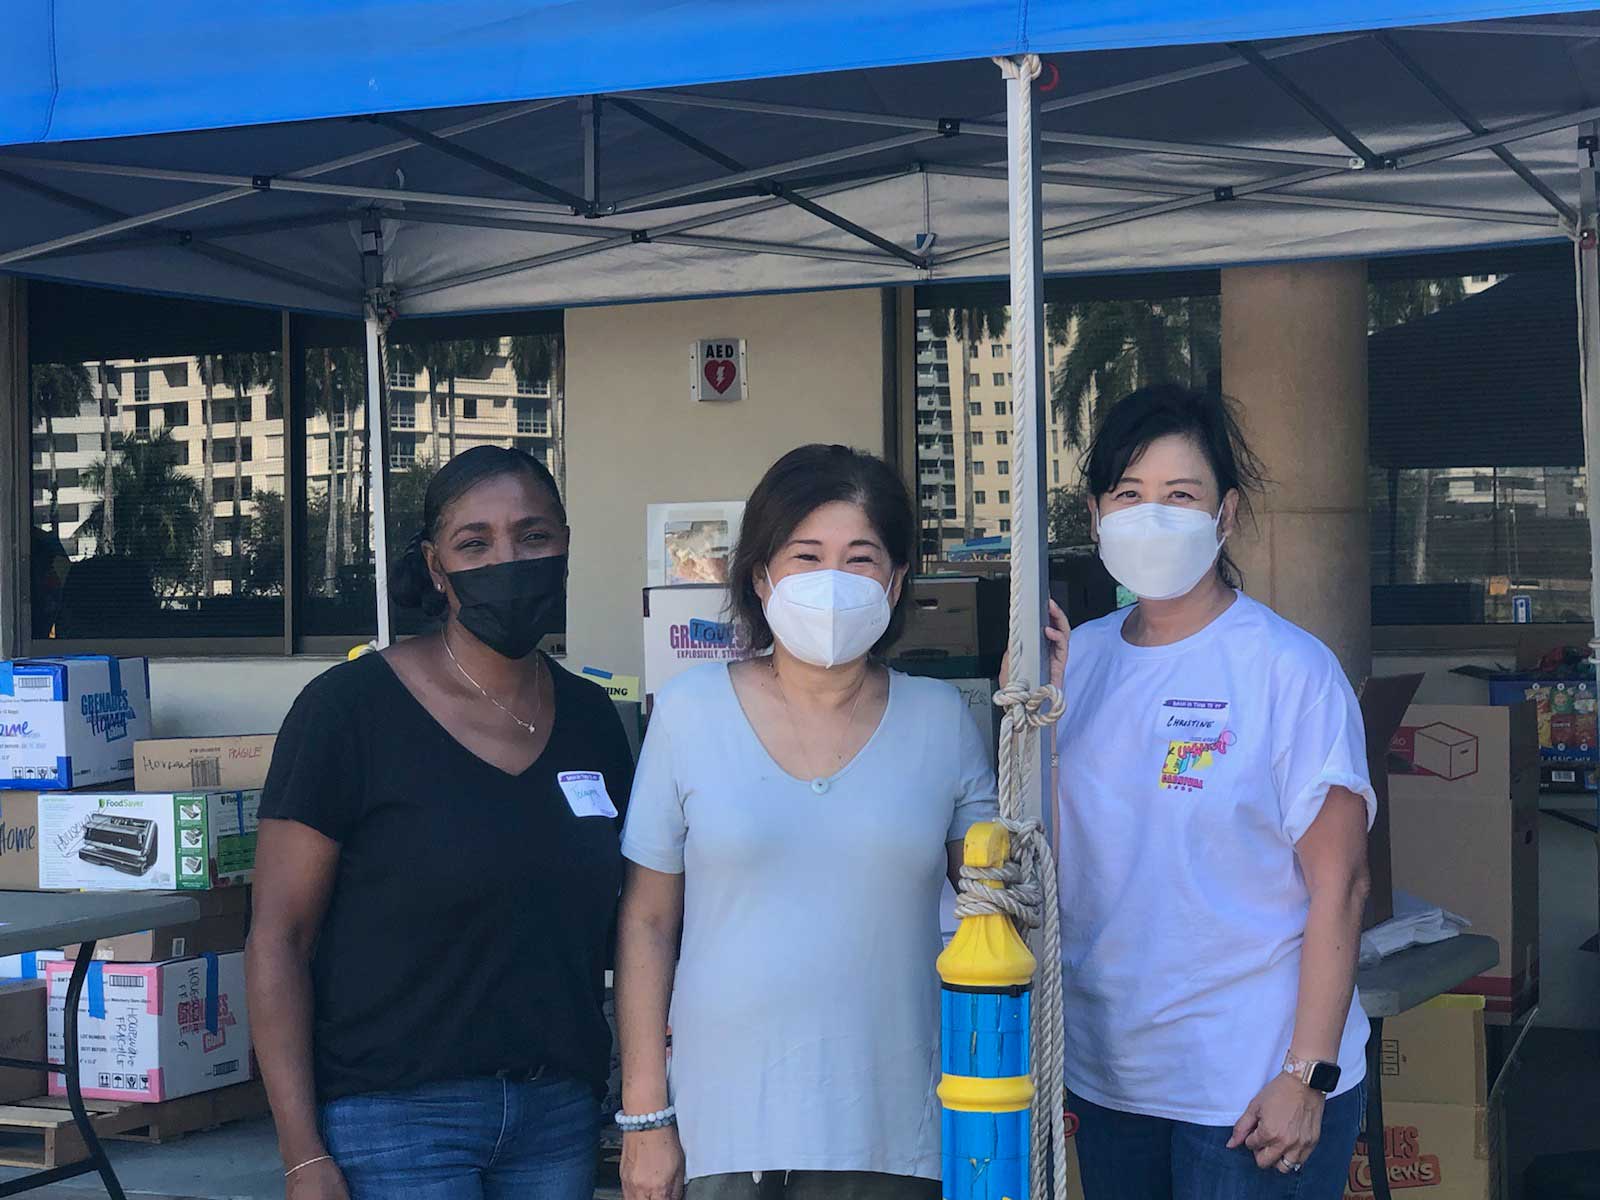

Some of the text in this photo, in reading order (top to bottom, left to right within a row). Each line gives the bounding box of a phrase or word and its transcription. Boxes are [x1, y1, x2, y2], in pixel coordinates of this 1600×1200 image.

[706, 344, 734, 358] AED
[606, 687, 628, 696] ING
[106, 799, 145, 808] FoodSaver
[1356, 1160, 1435, 1188] Cews
